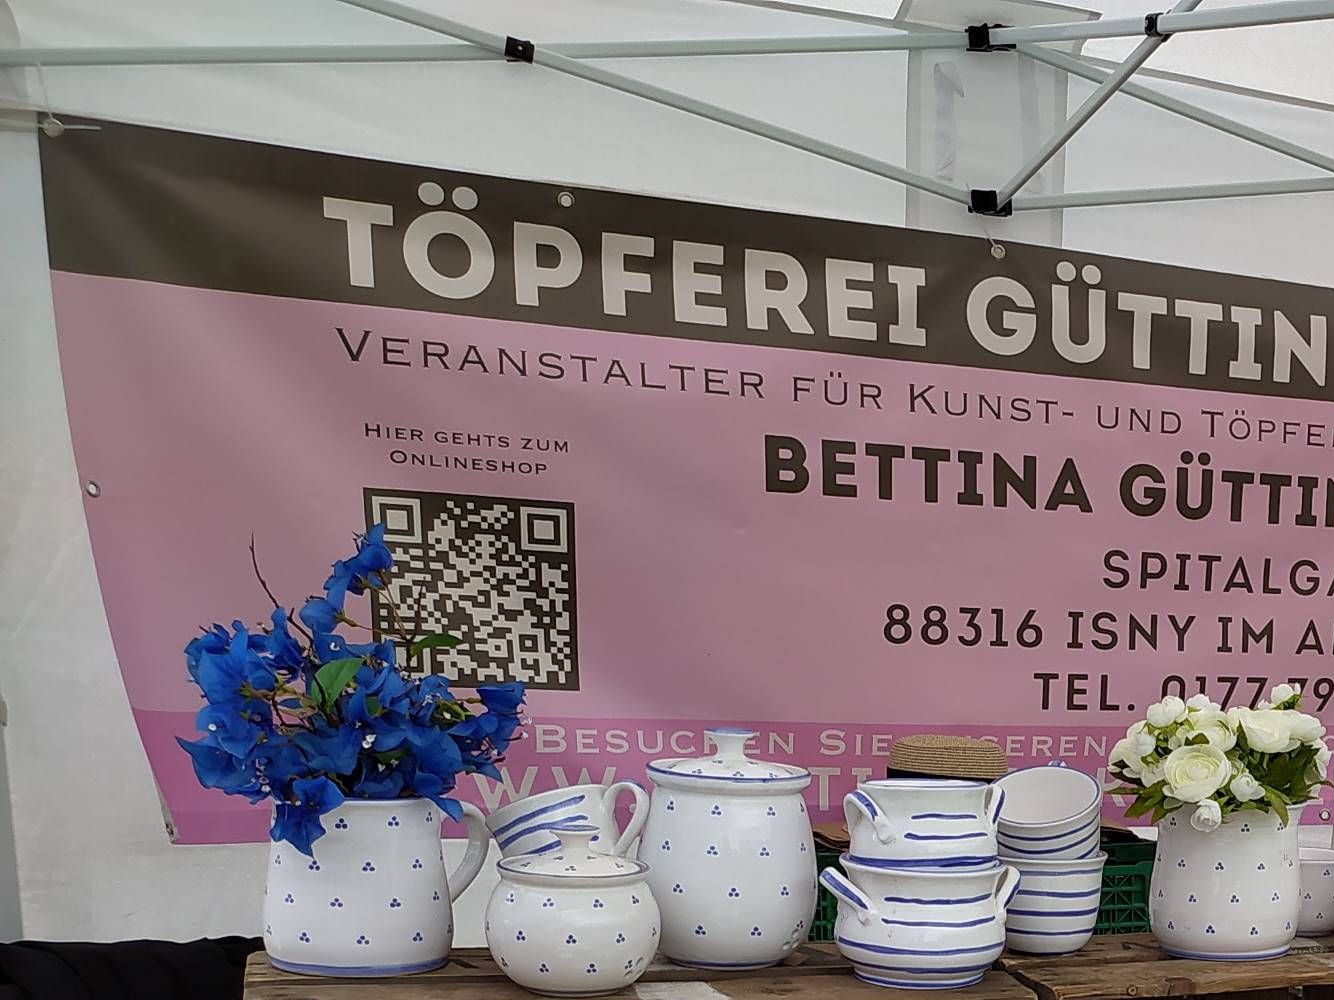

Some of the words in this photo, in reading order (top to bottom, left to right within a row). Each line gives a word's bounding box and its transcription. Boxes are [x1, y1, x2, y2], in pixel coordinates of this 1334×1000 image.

[322, 181, 928, 348] TÖPFEREI
[334, 326, 766, 399] VERANSTALTER
[791, 369, 884, 410] FÜR
[908, 383, 1075, 425] KUNST-
[1096, 404, 1183, 436] UND
[363, 422, 425, 443] HIER
[434, 430, 511, 449] GEHTS
[520, 436, 570, 454] ZUM
[388, 449, 549, 476] ONLINESHOP
[763, 434, 1093, 515] BETTINA
[883, 604, 1044, 649] 88316
[1066, 610, 1196, 652] ISNY
[1216, 616, 1275, 654] IM
[1033, 672, 1136, 712] TEL.
[819, 728, 893, 757] SIE
